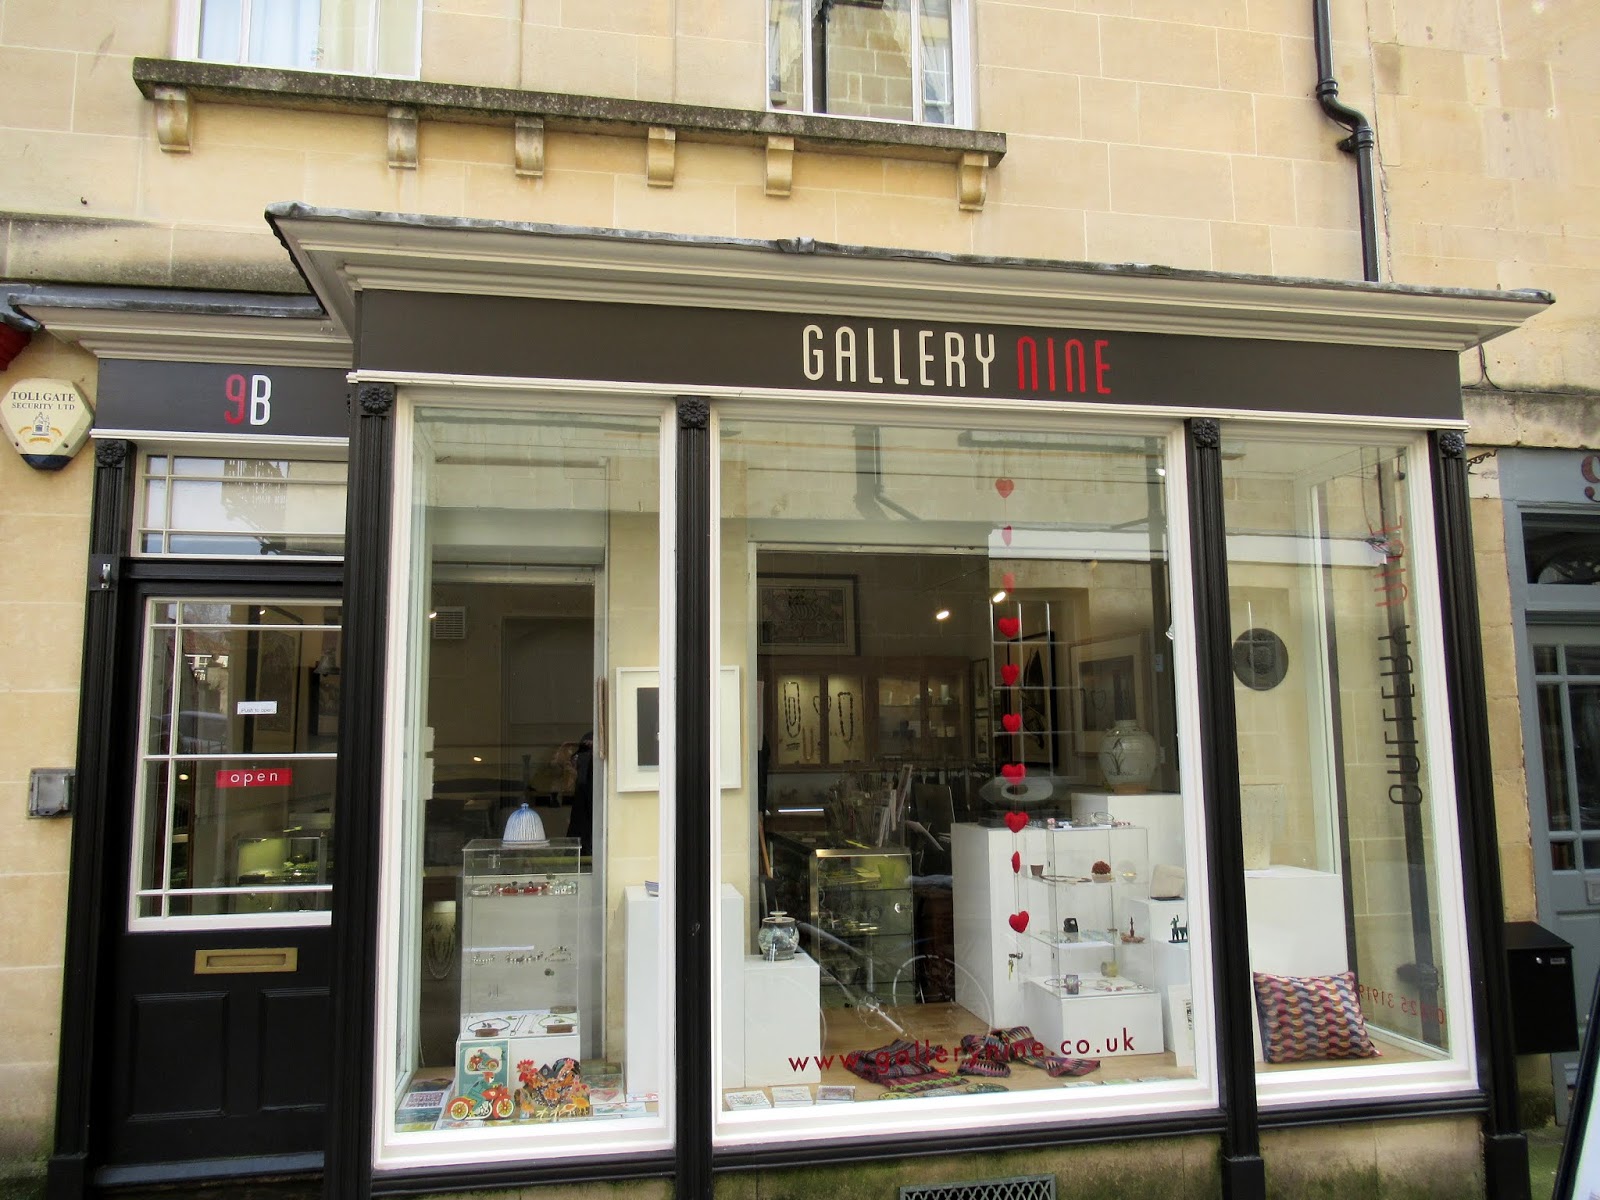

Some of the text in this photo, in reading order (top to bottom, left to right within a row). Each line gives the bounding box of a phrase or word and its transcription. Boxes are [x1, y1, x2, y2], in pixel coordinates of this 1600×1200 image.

[802, 324, 1111, 394] GALLERY NINE
[11, 391, 76, 402] TOLLGATE
[12, 402, 54, 410] SECURITY
[224, 373, 272, 426] 9B
[230, 772, 278, 787] open
[788, 1027, 1135, 1075] www.gallerynine.co.uk
